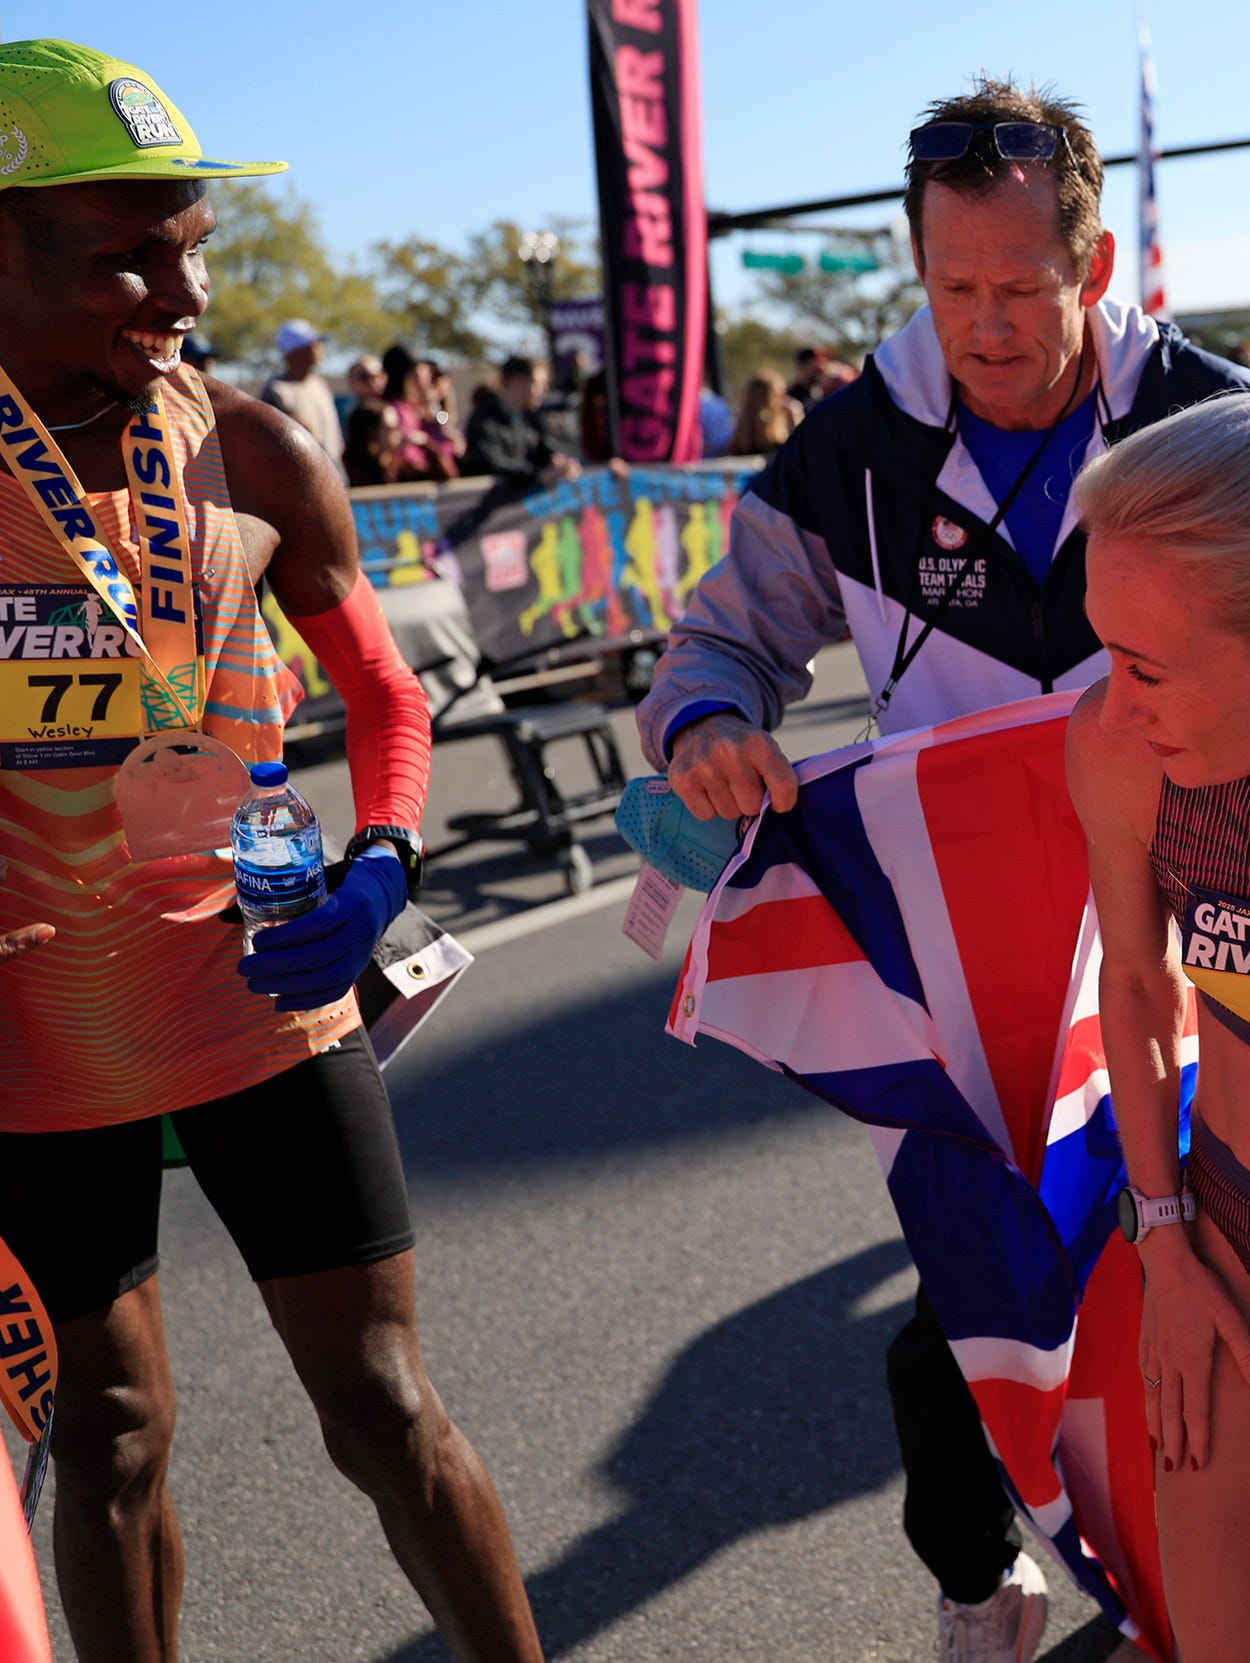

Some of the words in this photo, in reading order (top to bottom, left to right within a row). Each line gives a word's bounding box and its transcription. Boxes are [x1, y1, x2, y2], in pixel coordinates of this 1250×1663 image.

[131, 114, 166, 125] RIVER
[136, 123, 175, 140] RUN
[615, 44, 675, 269] RIVER
[620, 283, 676, 462] GATE
[0, 394, 97, 543] RIVER
[80, 550, 139, 631] RU
[938, 558, 987, 574] OLYMIC
[919, 571, 946, 587] TEAM
[947, 573, 987, 589] TALS
[921, 587, 984, 599] MARHON
[28, 673, 123, 723] 77
[27, 723, 94, 739] Wesley
[1218, 900, 1236, 911] 2025
